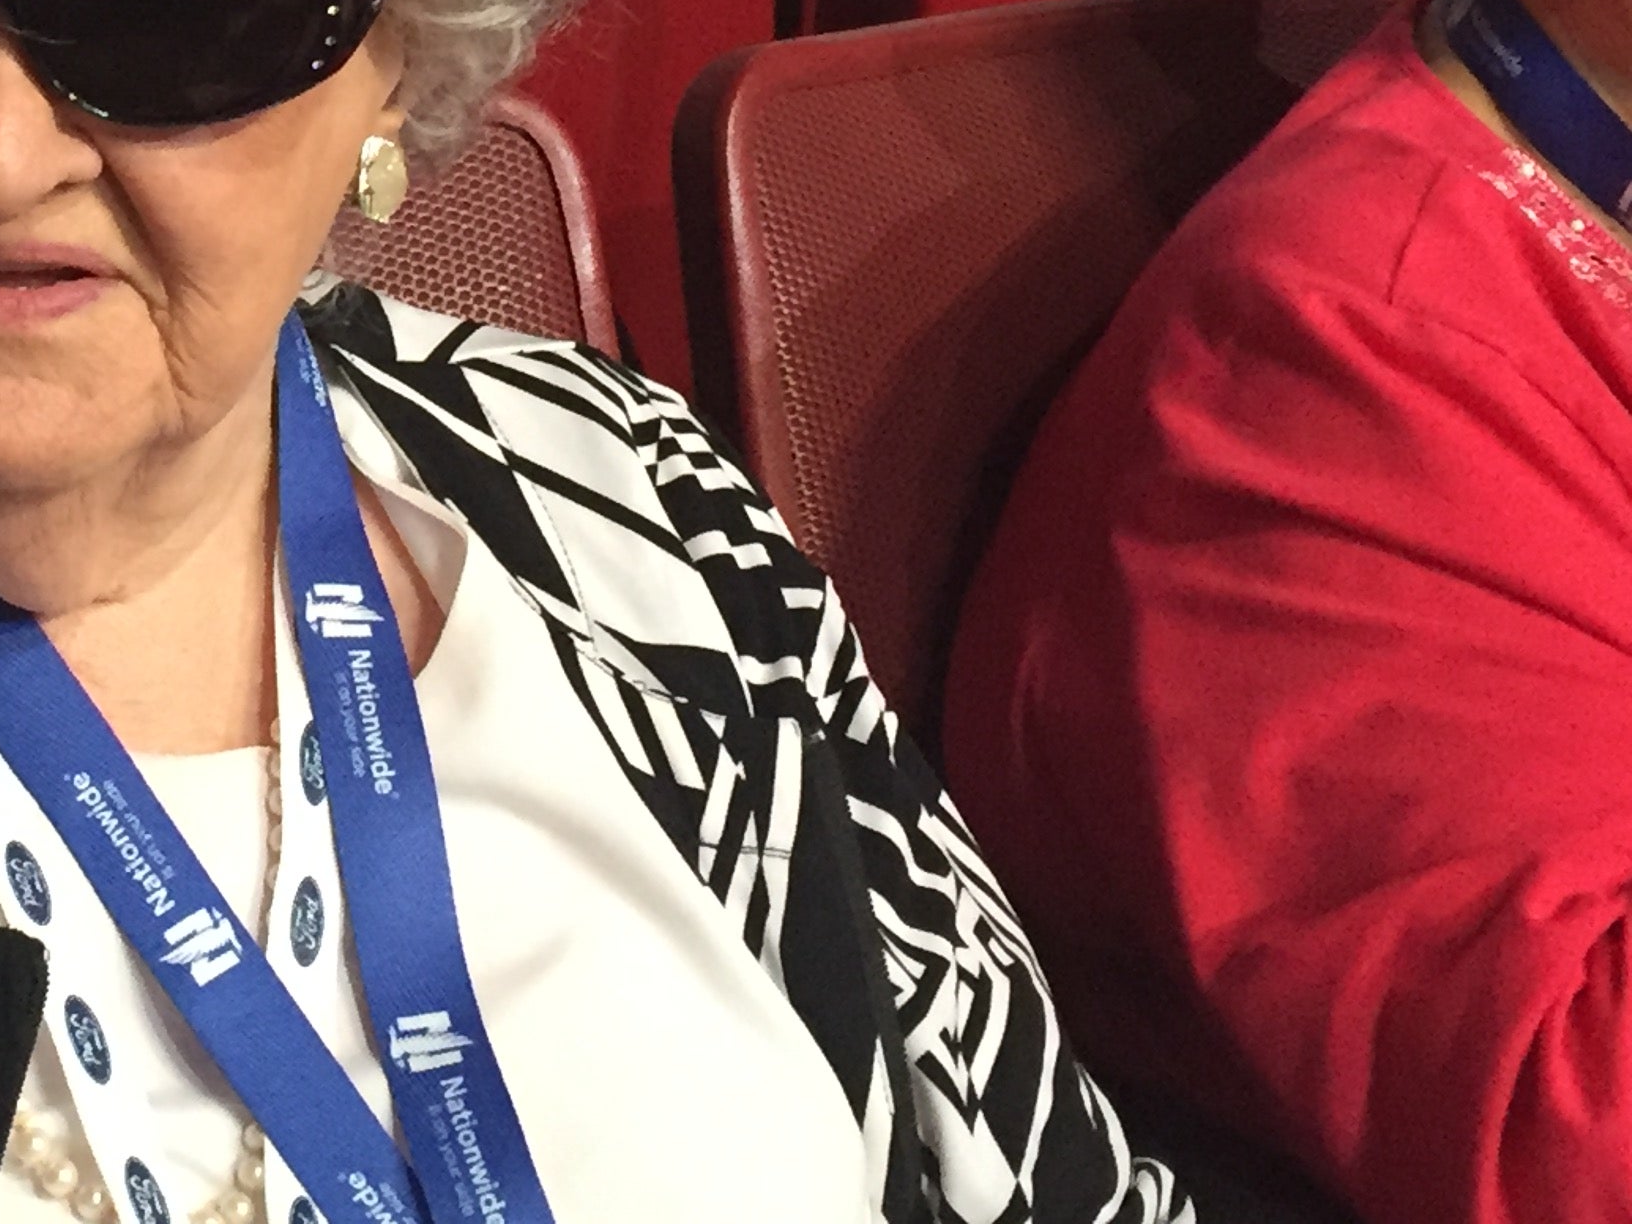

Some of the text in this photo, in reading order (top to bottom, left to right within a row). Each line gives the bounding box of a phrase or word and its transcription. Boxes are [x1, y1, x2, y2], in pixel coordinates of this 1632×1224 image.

[348, 649, 396, 795] Nationwide
[10, 858, 43, 907] Ford
[73, 771, 176, 917] Nationwide
[70, 1014, 102, 1065] Ford
[440, 1076, 506, 1224] Nationwide
